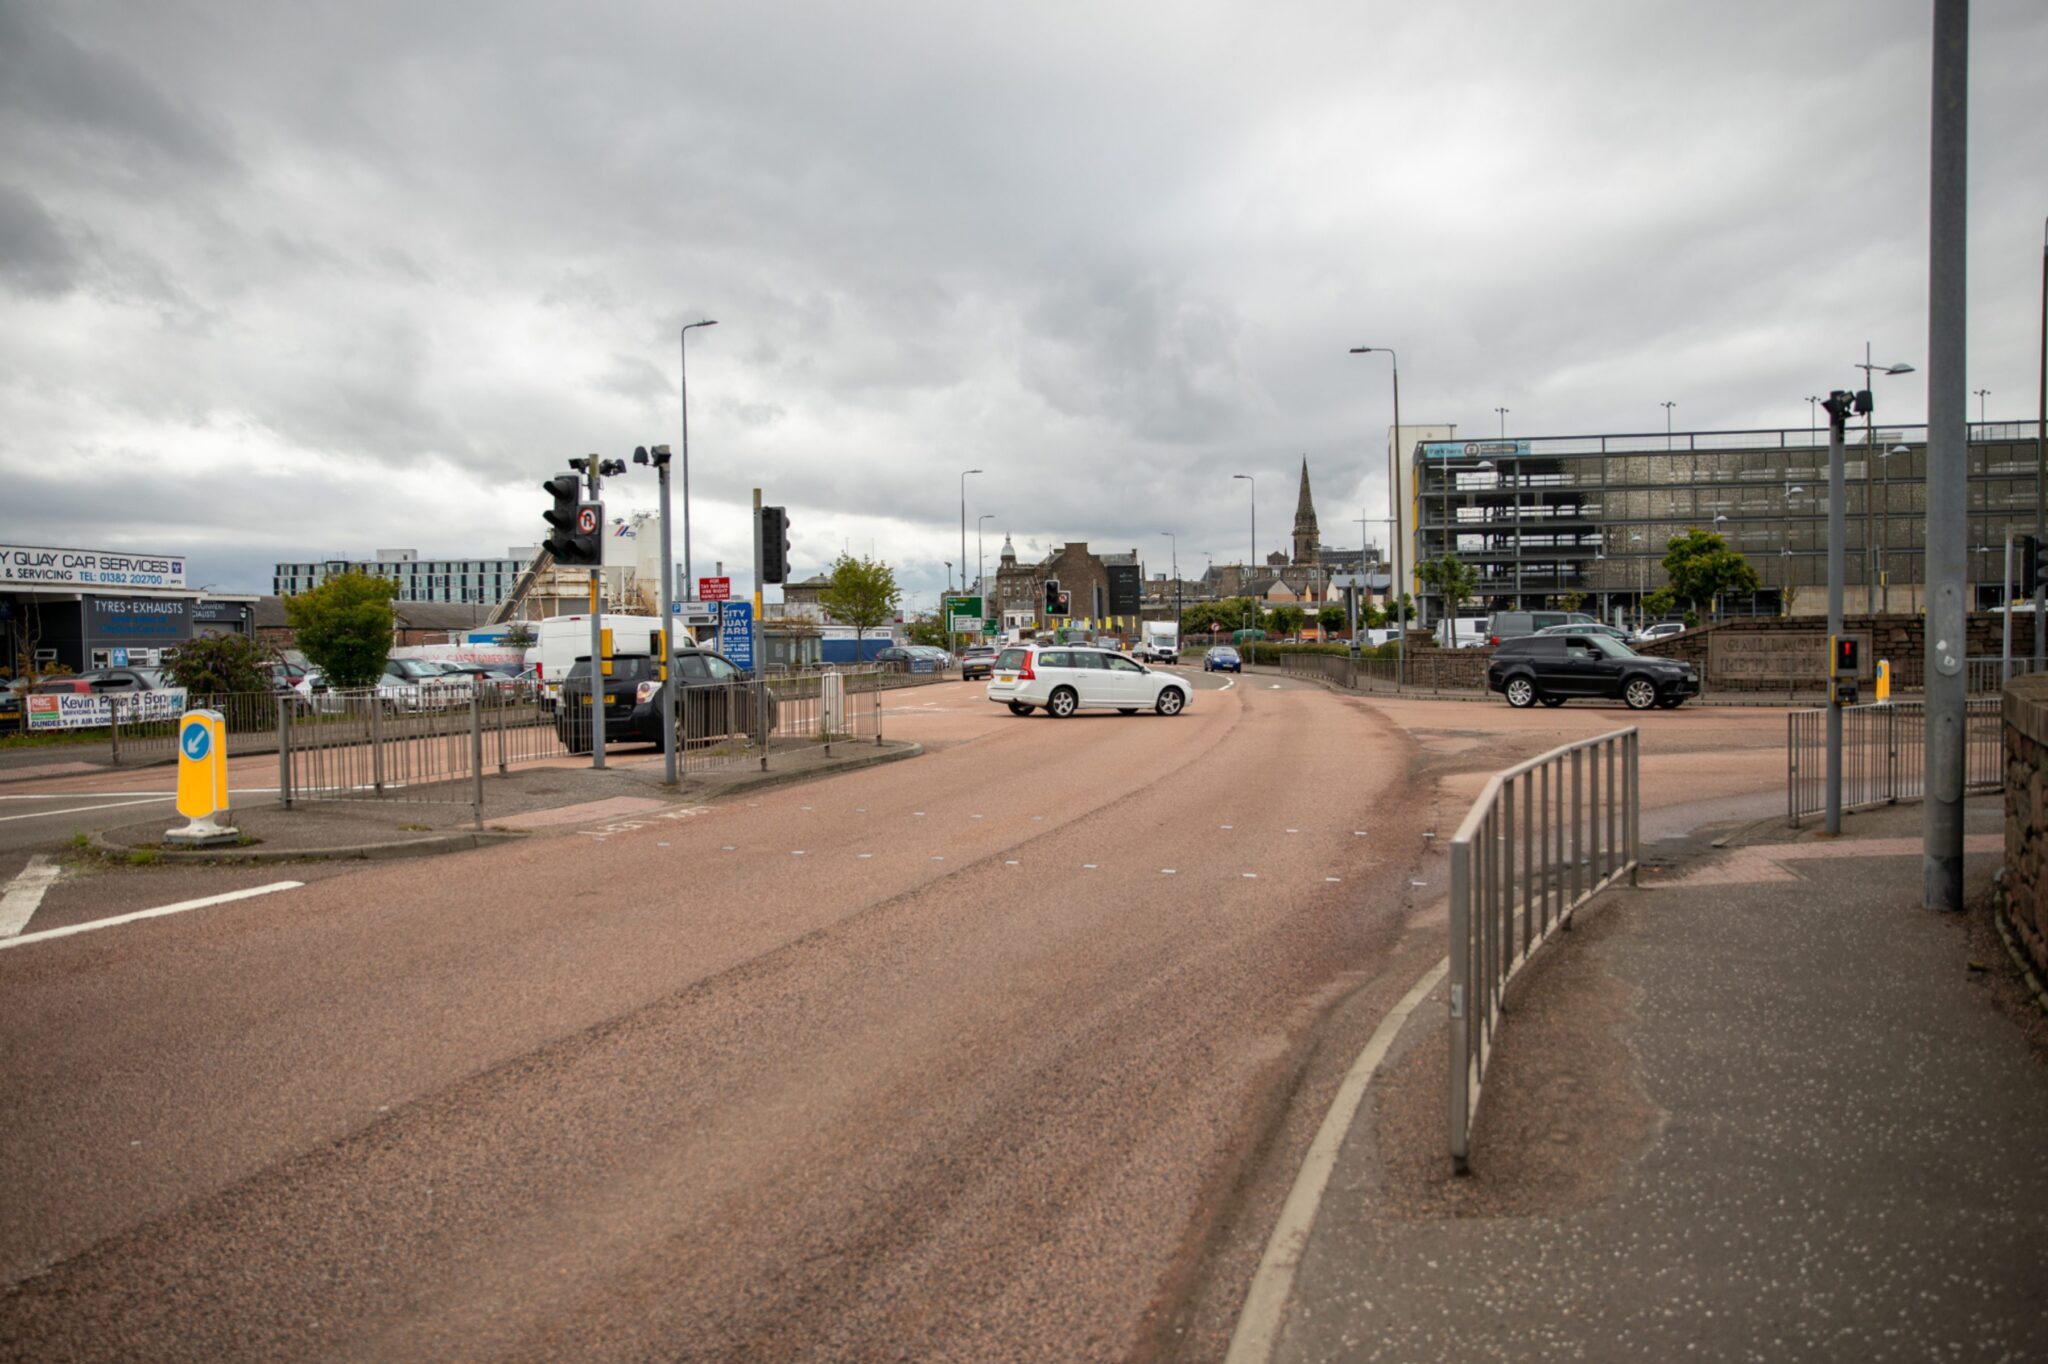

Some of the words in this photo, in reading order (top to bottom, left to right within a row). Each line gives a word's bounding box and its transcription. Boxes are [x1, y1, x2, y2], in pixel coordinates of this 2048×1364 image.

[14, 551, 58, 567] QUAY
[62, 554, 96, 569] CAR
[99, 556, 169, 574] SERVICES
[5, 568, 13, 578] &
[18, 568, 73, 581] SERVICING
[79, 571, 97, 582] TEL:
[100, 572, 127, 584] 01382
[130, 574, 162, 585] 202700
[95, 600, 126, 613] TYRES
[133, 602, 184, 614] EXHAUSTS
[61, 695, 95, 709] Kevin
[144, 692, 167, 705] Son
[81, 716, 93, 725] AIR
